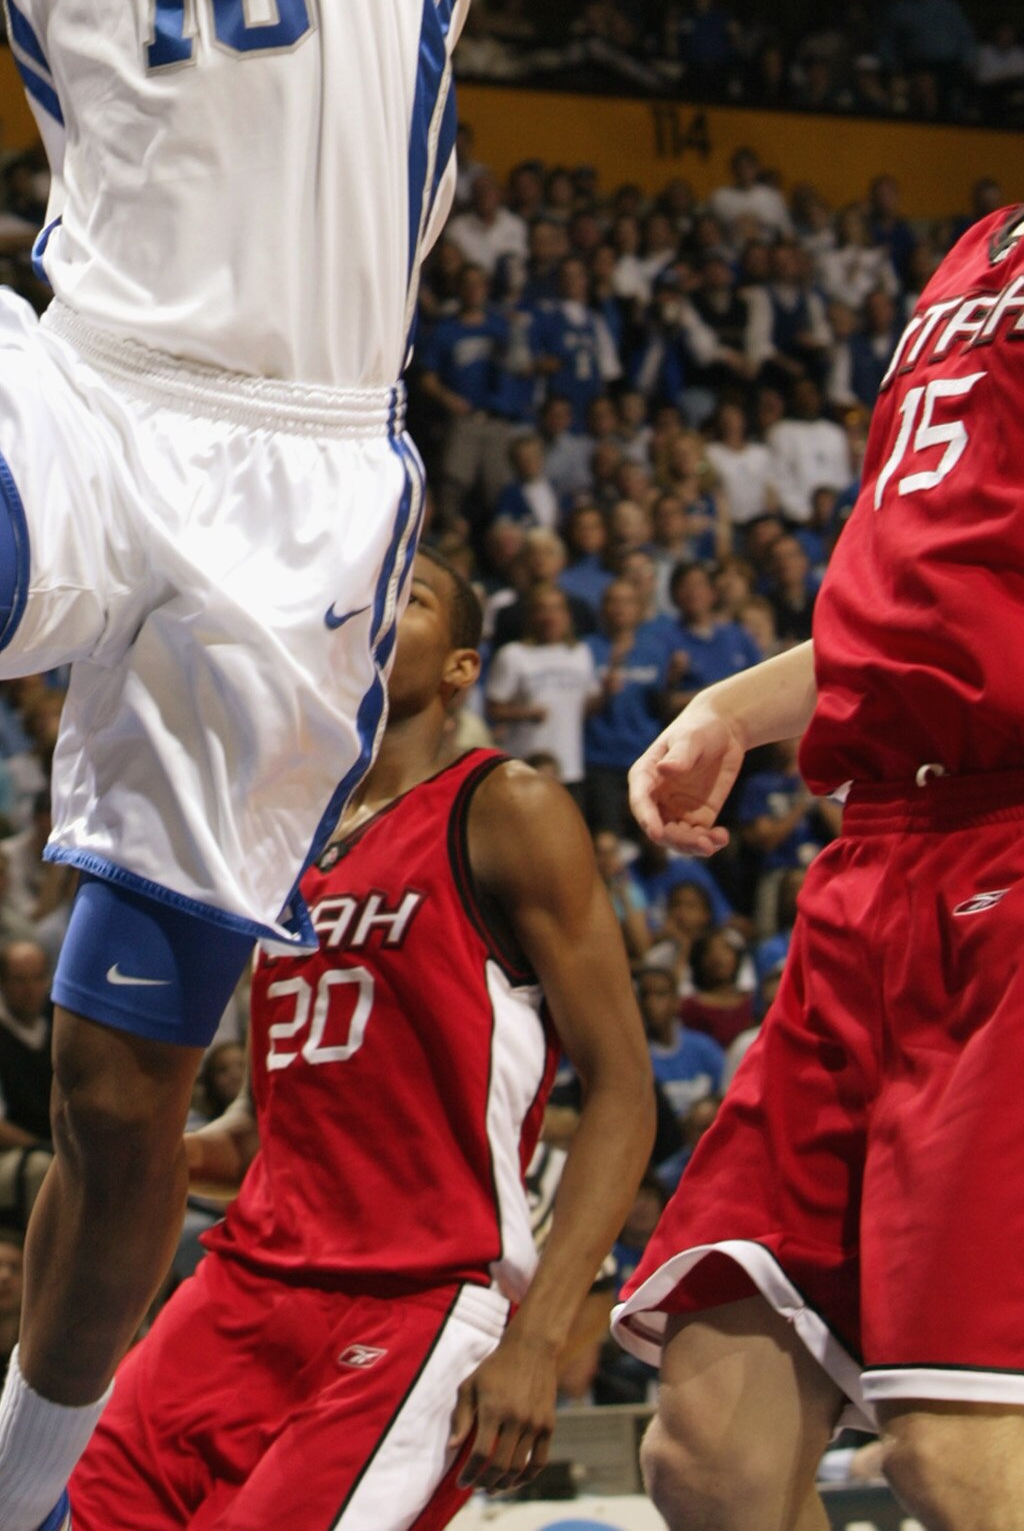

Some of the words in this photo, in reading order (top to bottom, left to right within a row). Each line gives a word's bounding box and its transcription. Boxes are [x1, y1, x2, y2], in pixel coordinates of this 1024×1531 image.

[874, 371, 988, 511] 15
[308, 889, 423, 952] AH
[266, 966, 374, 1072] 20
